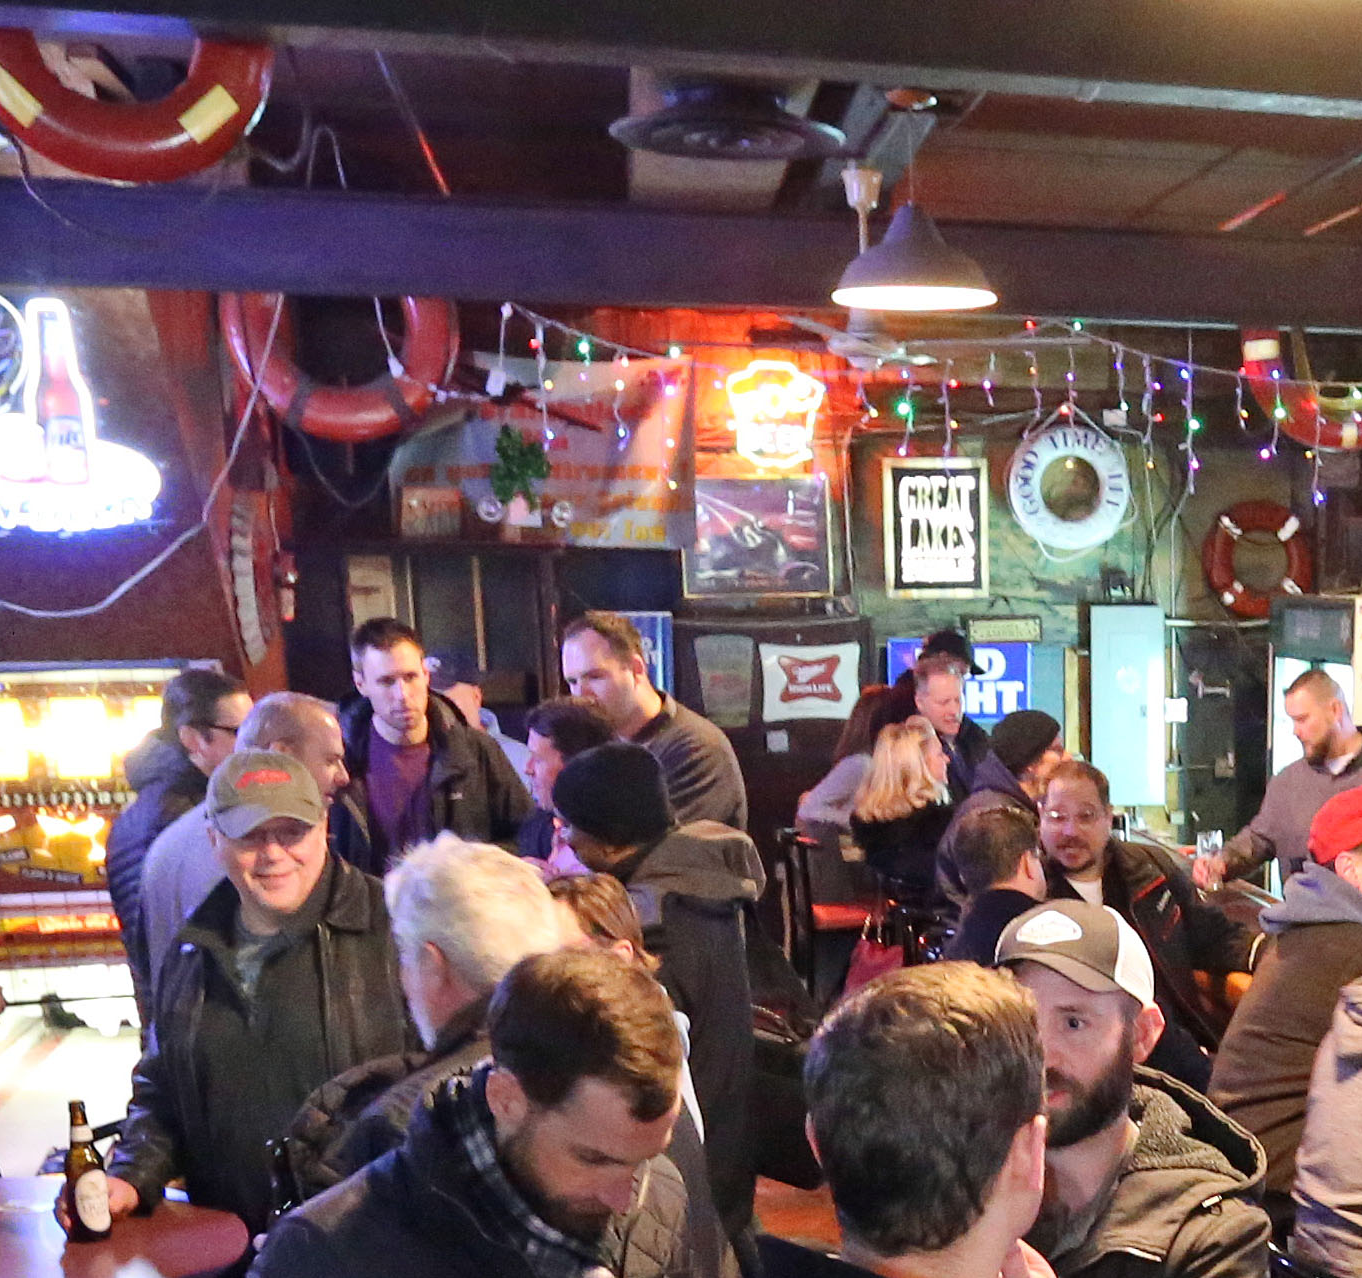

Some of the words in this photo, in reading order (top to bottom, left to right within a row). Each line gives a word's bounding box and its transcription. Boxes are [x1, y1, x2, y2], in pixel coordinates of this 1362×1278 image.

[1021, 450, 1039, 516] GOOD
[1049, 430, 1105, 452] TIME
[898, 475, 976, 517] GREAT
[901, 516, 976, 558] LAKES
